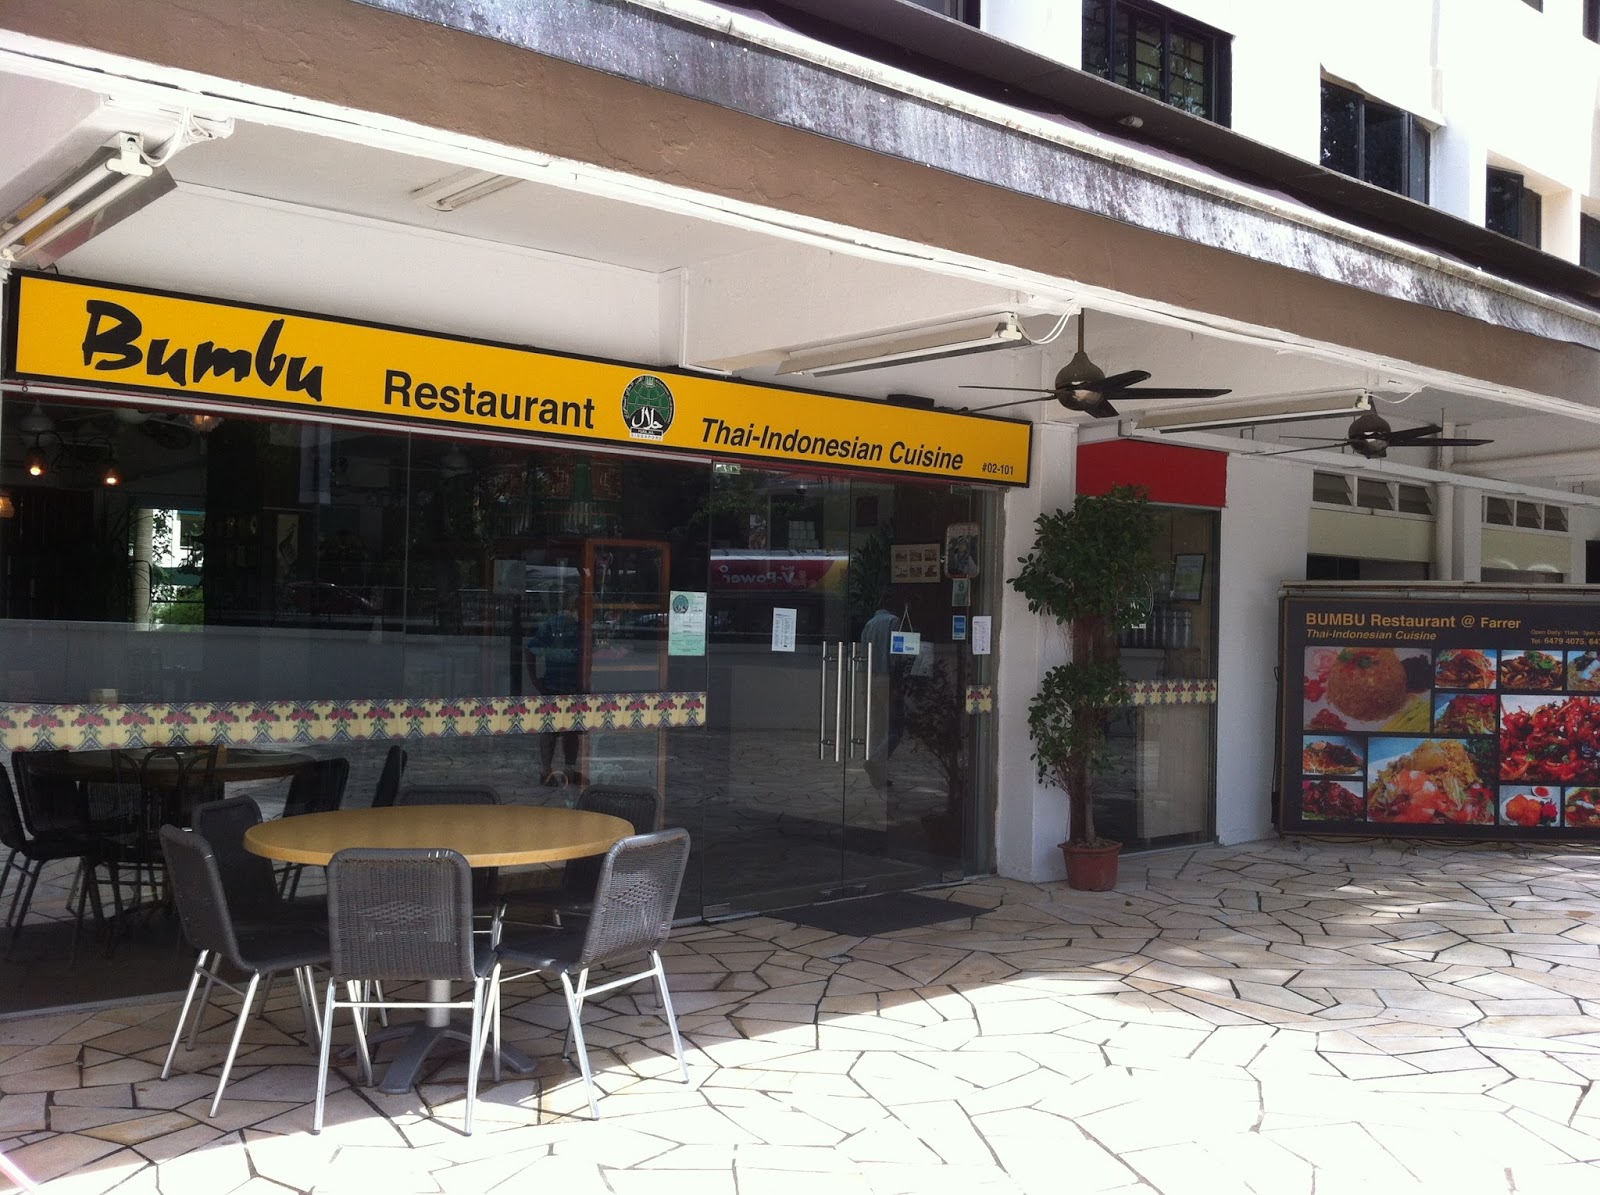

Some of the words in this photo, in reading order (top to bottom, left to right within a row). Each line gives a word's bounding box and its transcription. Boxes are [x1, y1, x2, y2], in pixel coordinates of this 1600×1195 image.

[82, 300, 323, 402] Bumbu
[384, 369, 595, 429] Restaurant
[631, 406, 663, 430] حلال
[701, 418, 882, 463] Thai-Indonesian
[889, 441, 964, 471] Cuisine
[982, 462, 1014, 475] #02-101
[1306, 612, 1365, 626] BUMBU
[1371, 614, 1455, 628] Restaurant
[1461, 615, 1475, 628] @
[1481, 617, 1521, 629] Farrer
[1307, 629, 1392, 639] Thai-Indonesian
[1395, 630, 1437, 640] Cuisine
[1544, 637, 1563, 645] 6479
